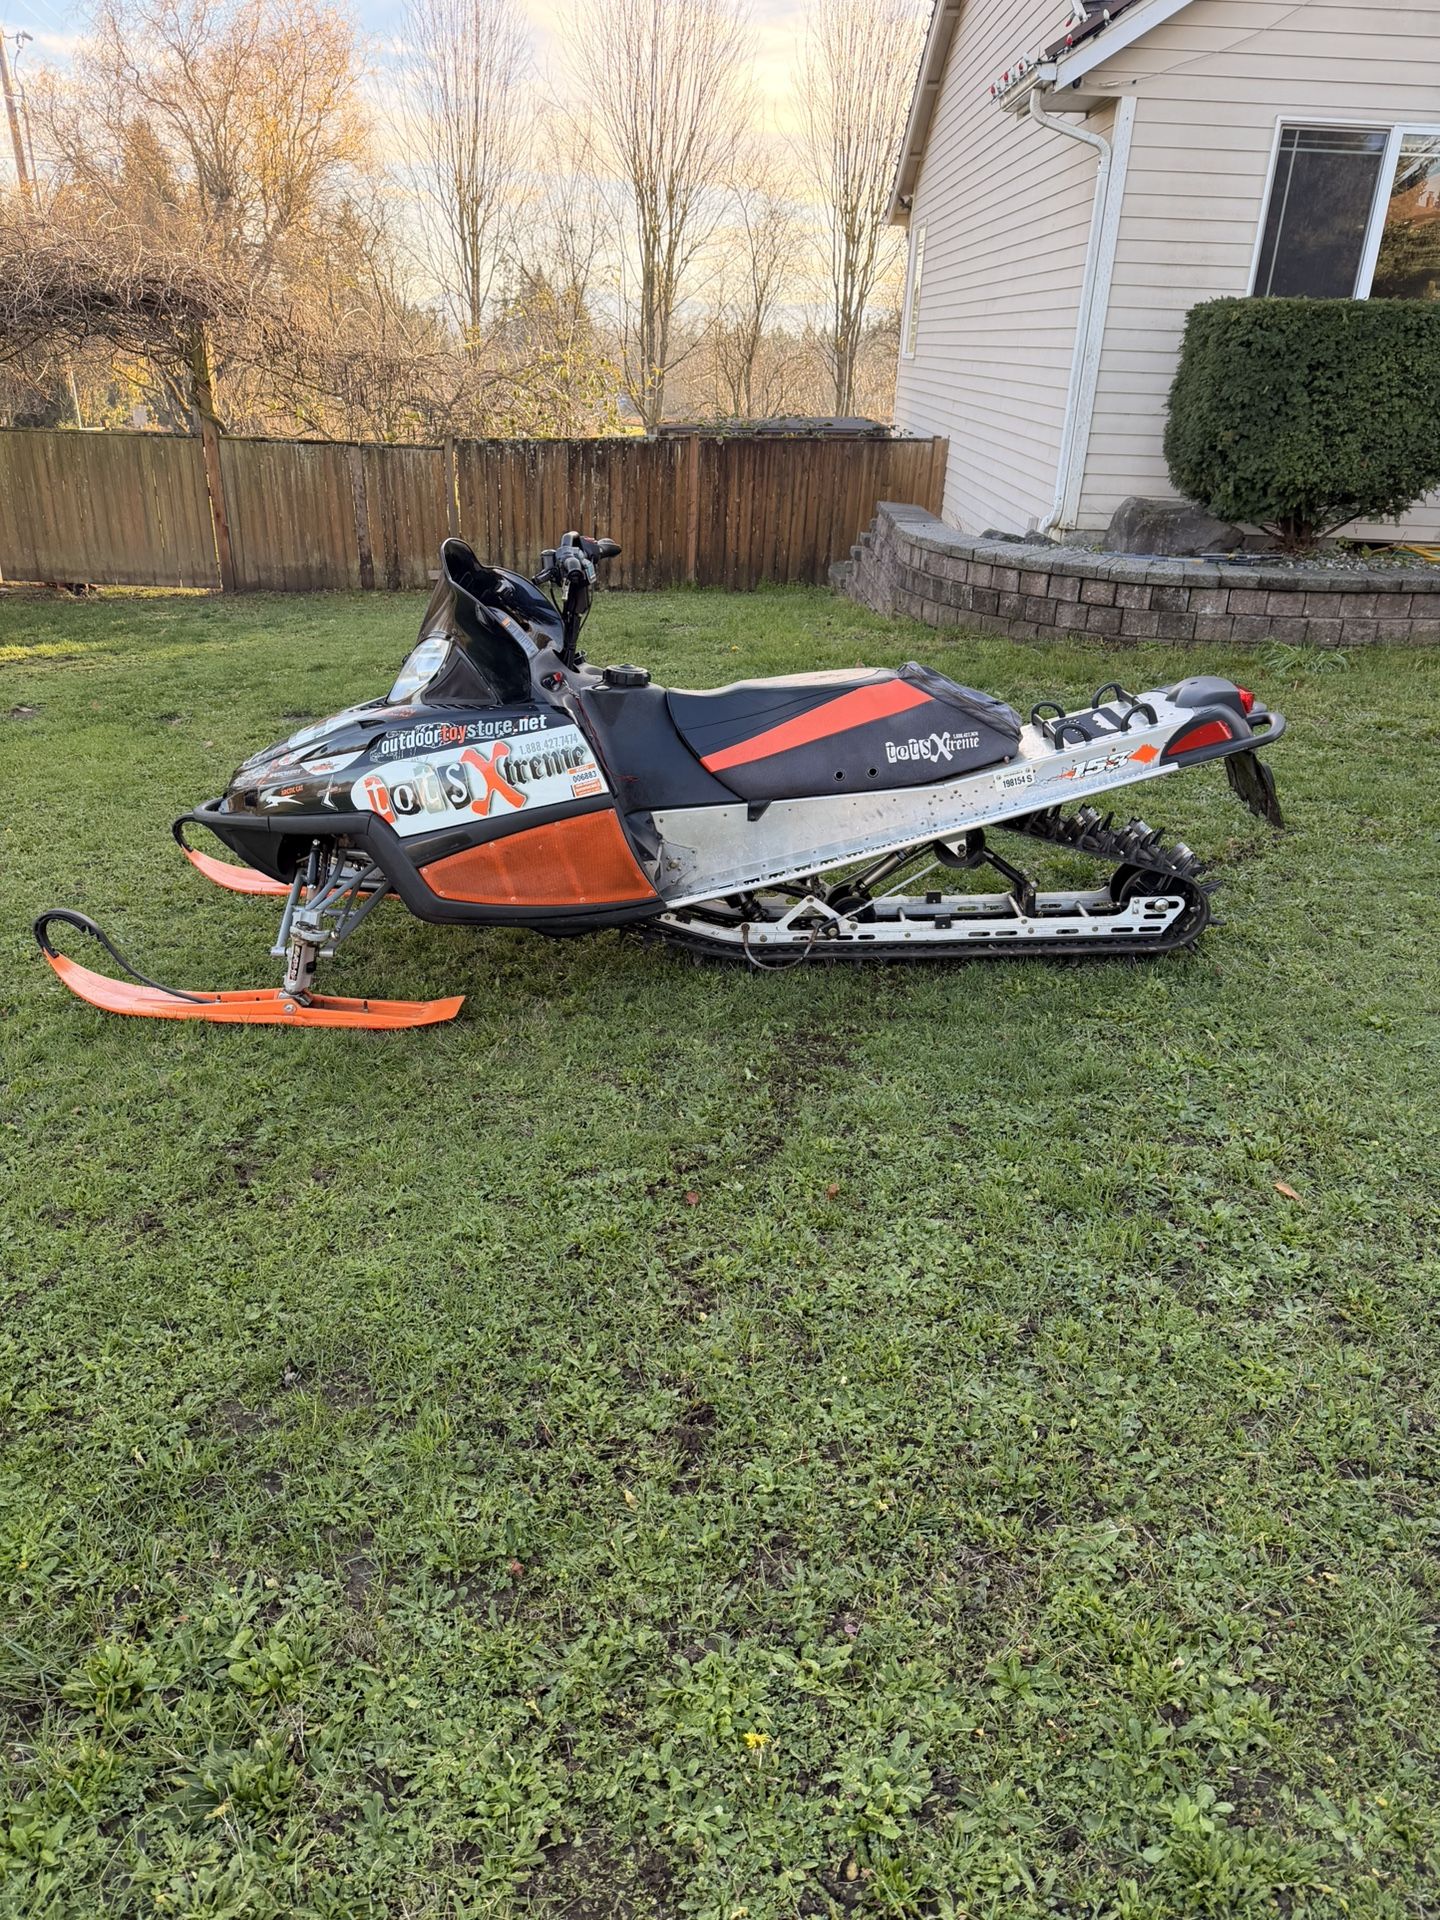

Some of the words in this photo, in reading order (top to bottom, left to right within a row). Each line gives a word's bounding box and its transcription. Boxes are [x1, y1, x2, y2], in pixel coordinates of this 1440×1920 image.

[381, 714, 547, 755] outdoortoystore.net
[519, 733, 579, 755] 1.888.427.7474
[572, 770, 597, 783] 006883
[1002, 775, 1026, 788] 198154
